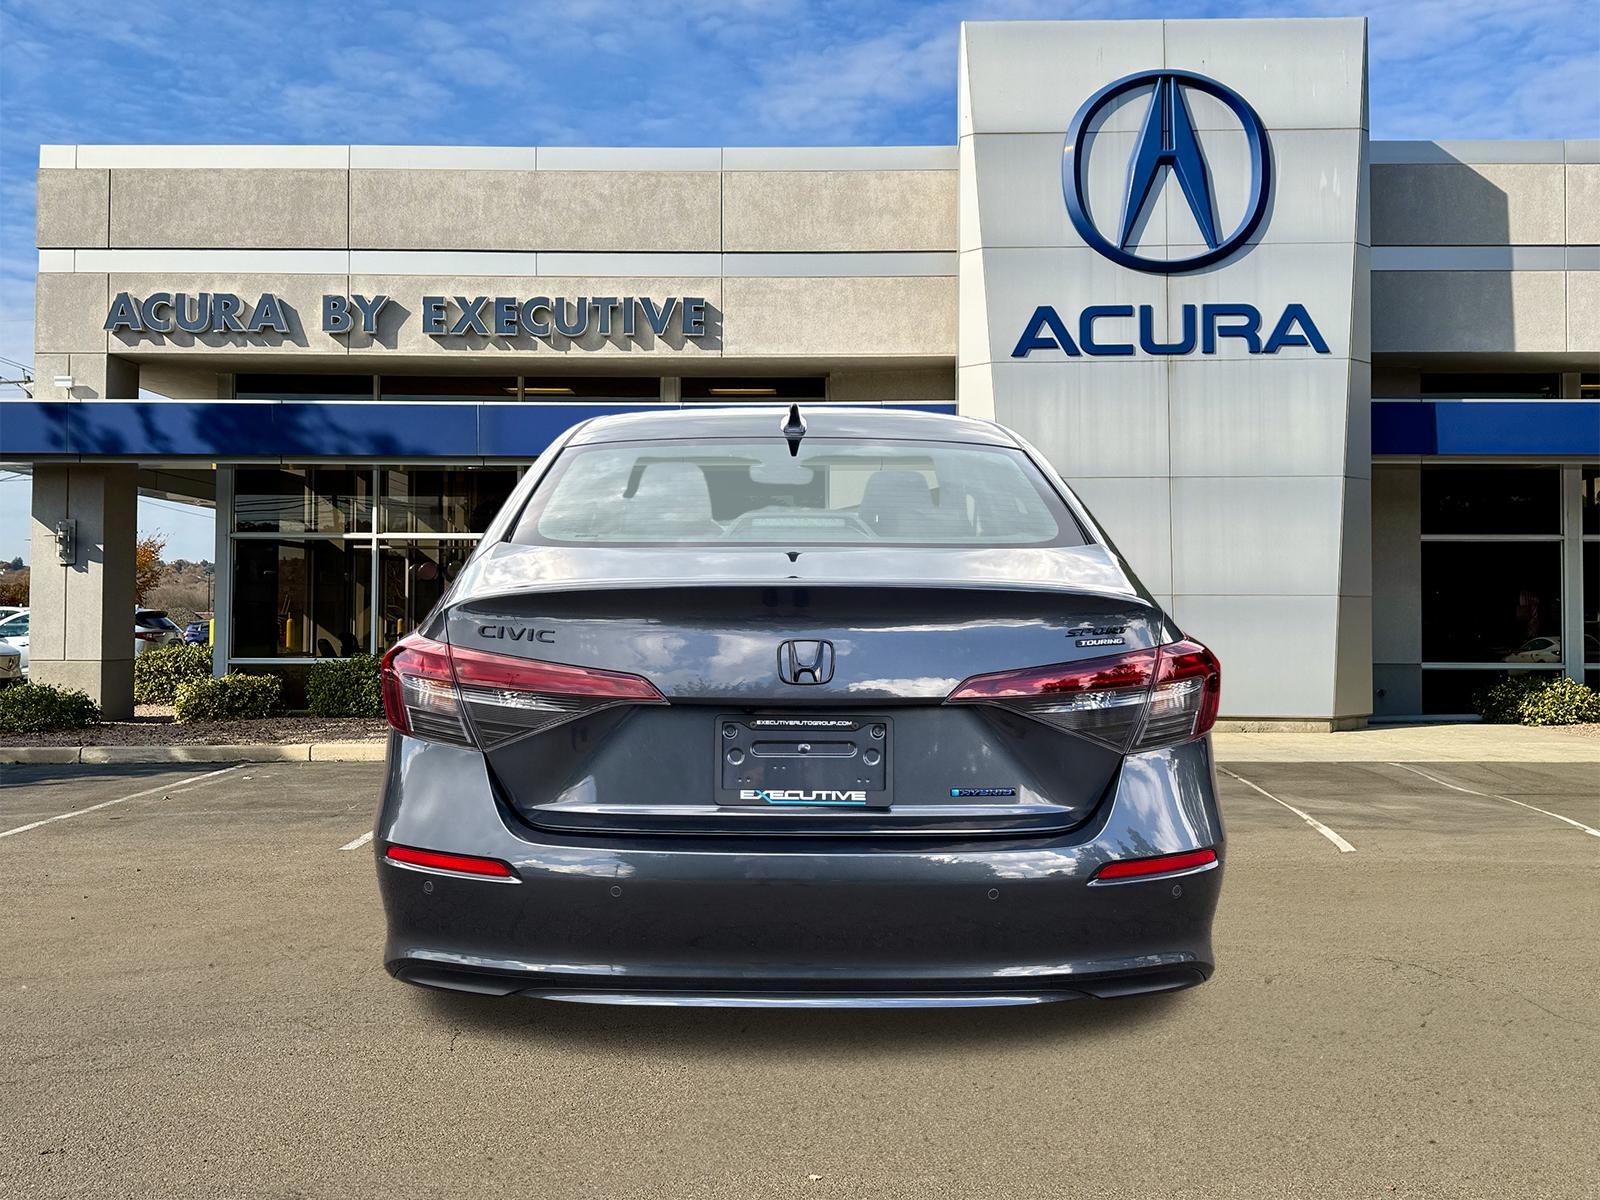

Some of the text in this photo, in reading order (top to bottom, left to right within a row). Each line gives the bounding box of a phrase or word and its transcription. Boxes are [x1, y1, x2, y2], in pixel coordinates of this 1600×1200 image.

[103, 291, 706, 337] ACURA BY EXECUTIVE
[1010, 303, 1331, 358] ACURA
[478, 624, 556, 644] CIVIC
[1065, 626, 1128, 637] SPORT
[1080, 638, 1123, 646] TOURING
[740, 789, 866, 802] EXECUTIVE
